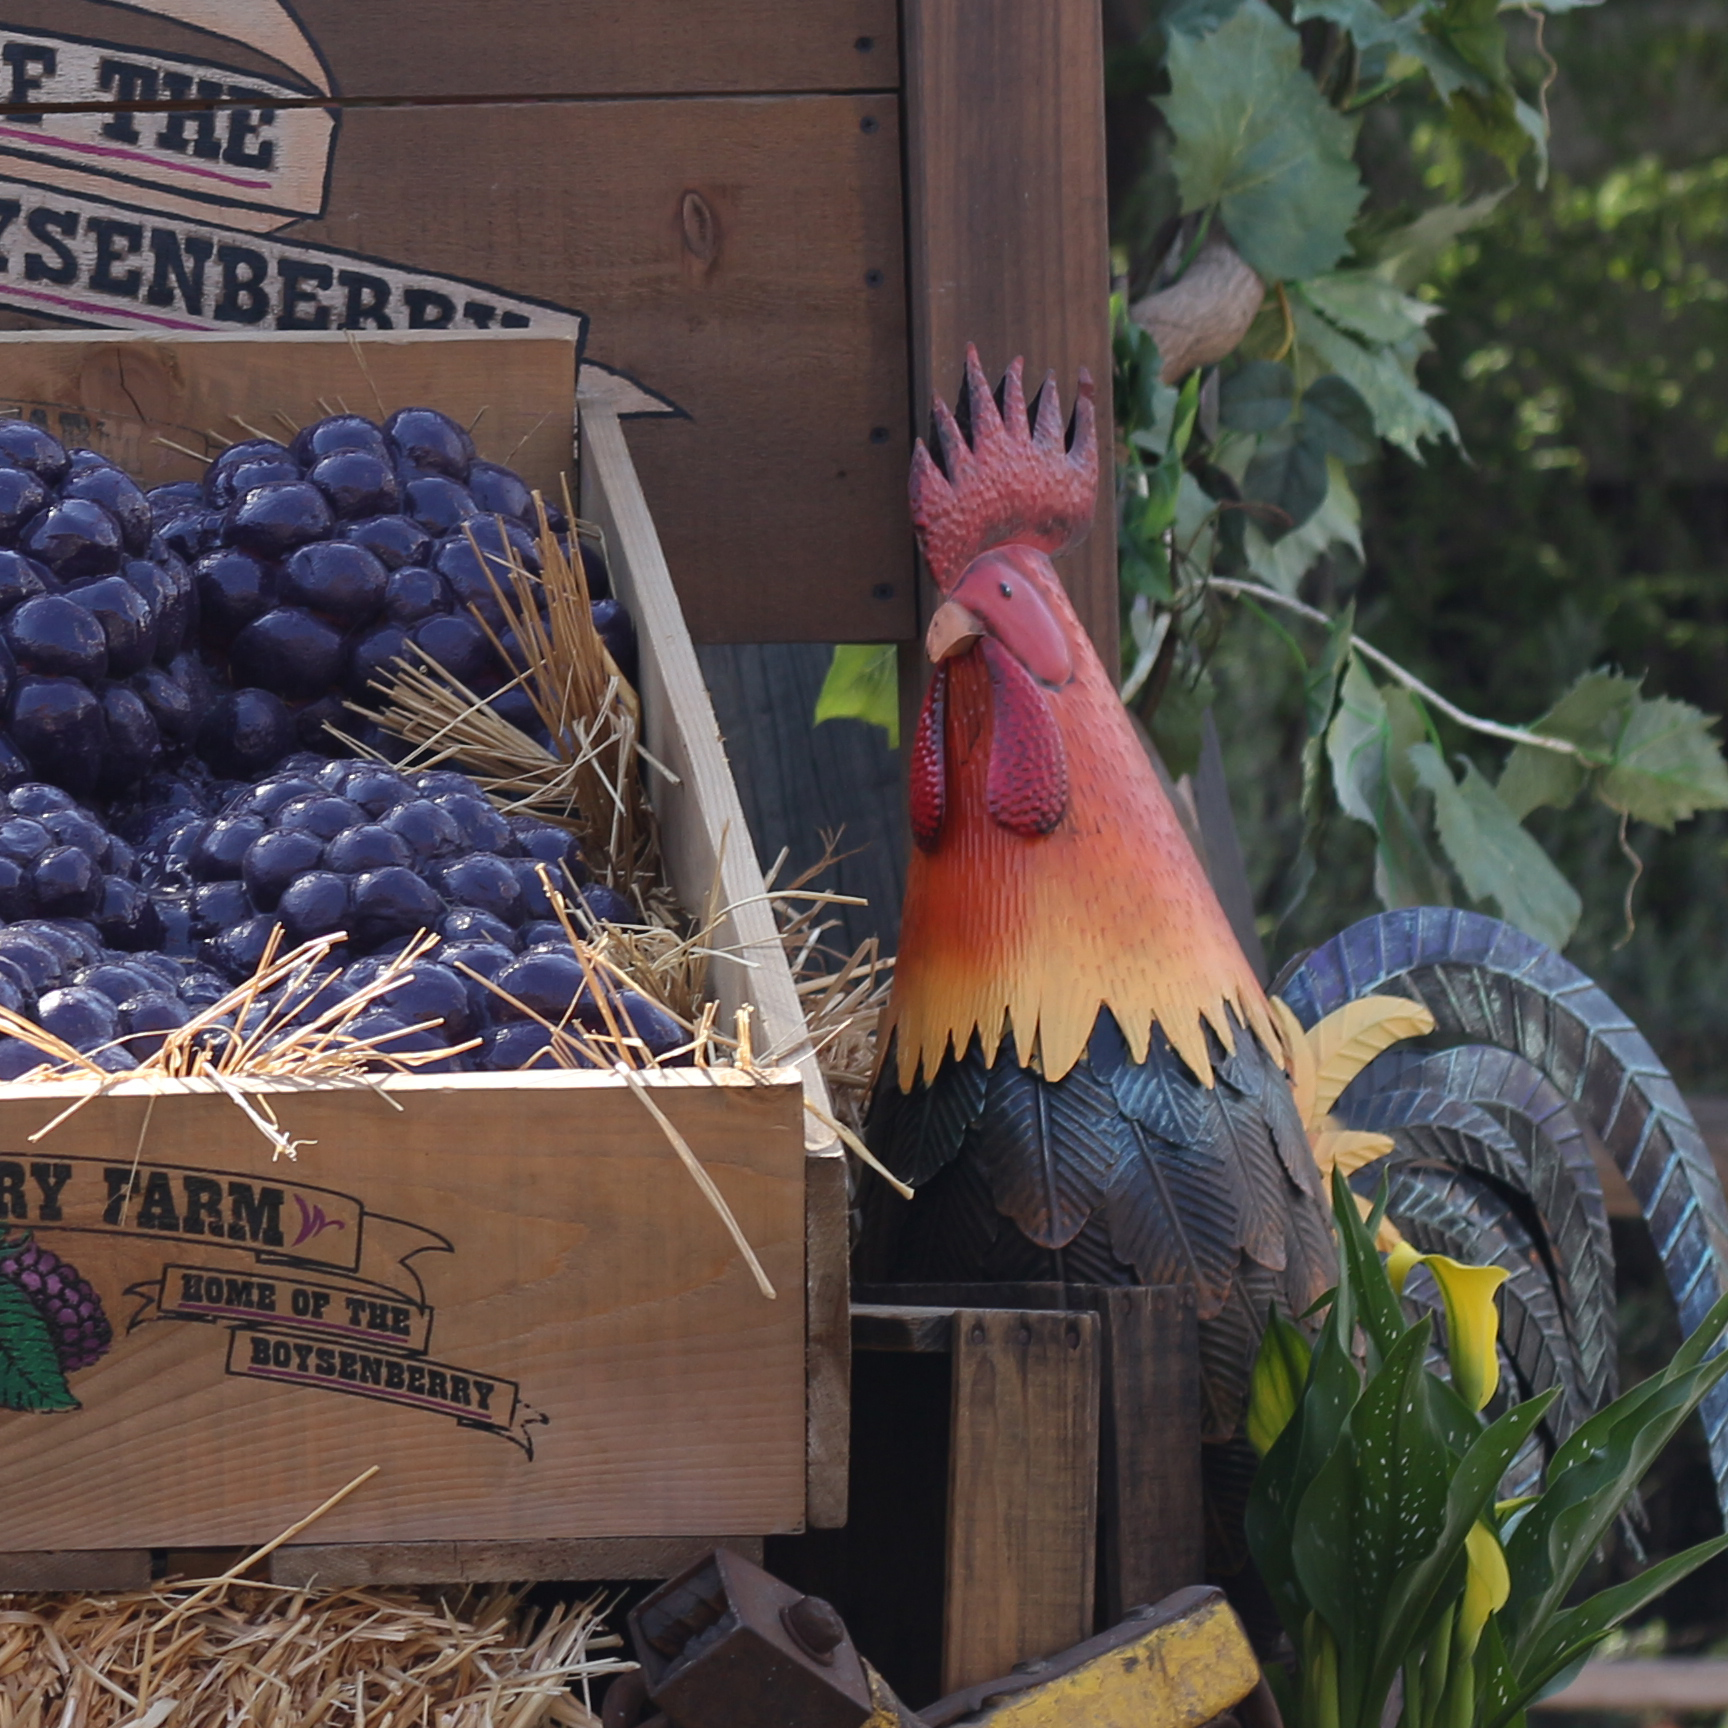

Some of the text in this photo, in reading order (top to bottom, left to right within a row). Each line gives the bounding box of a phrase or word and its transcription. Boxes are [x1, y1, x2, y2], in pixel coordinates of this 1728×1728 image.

[95, 56, 276, 172] THE
[102, 1166, 285, 1248] FARM
[180, 1272, 412, 1337] HOME OF THE
[249, 1334, 495, 1411] BOYSENBERRY
